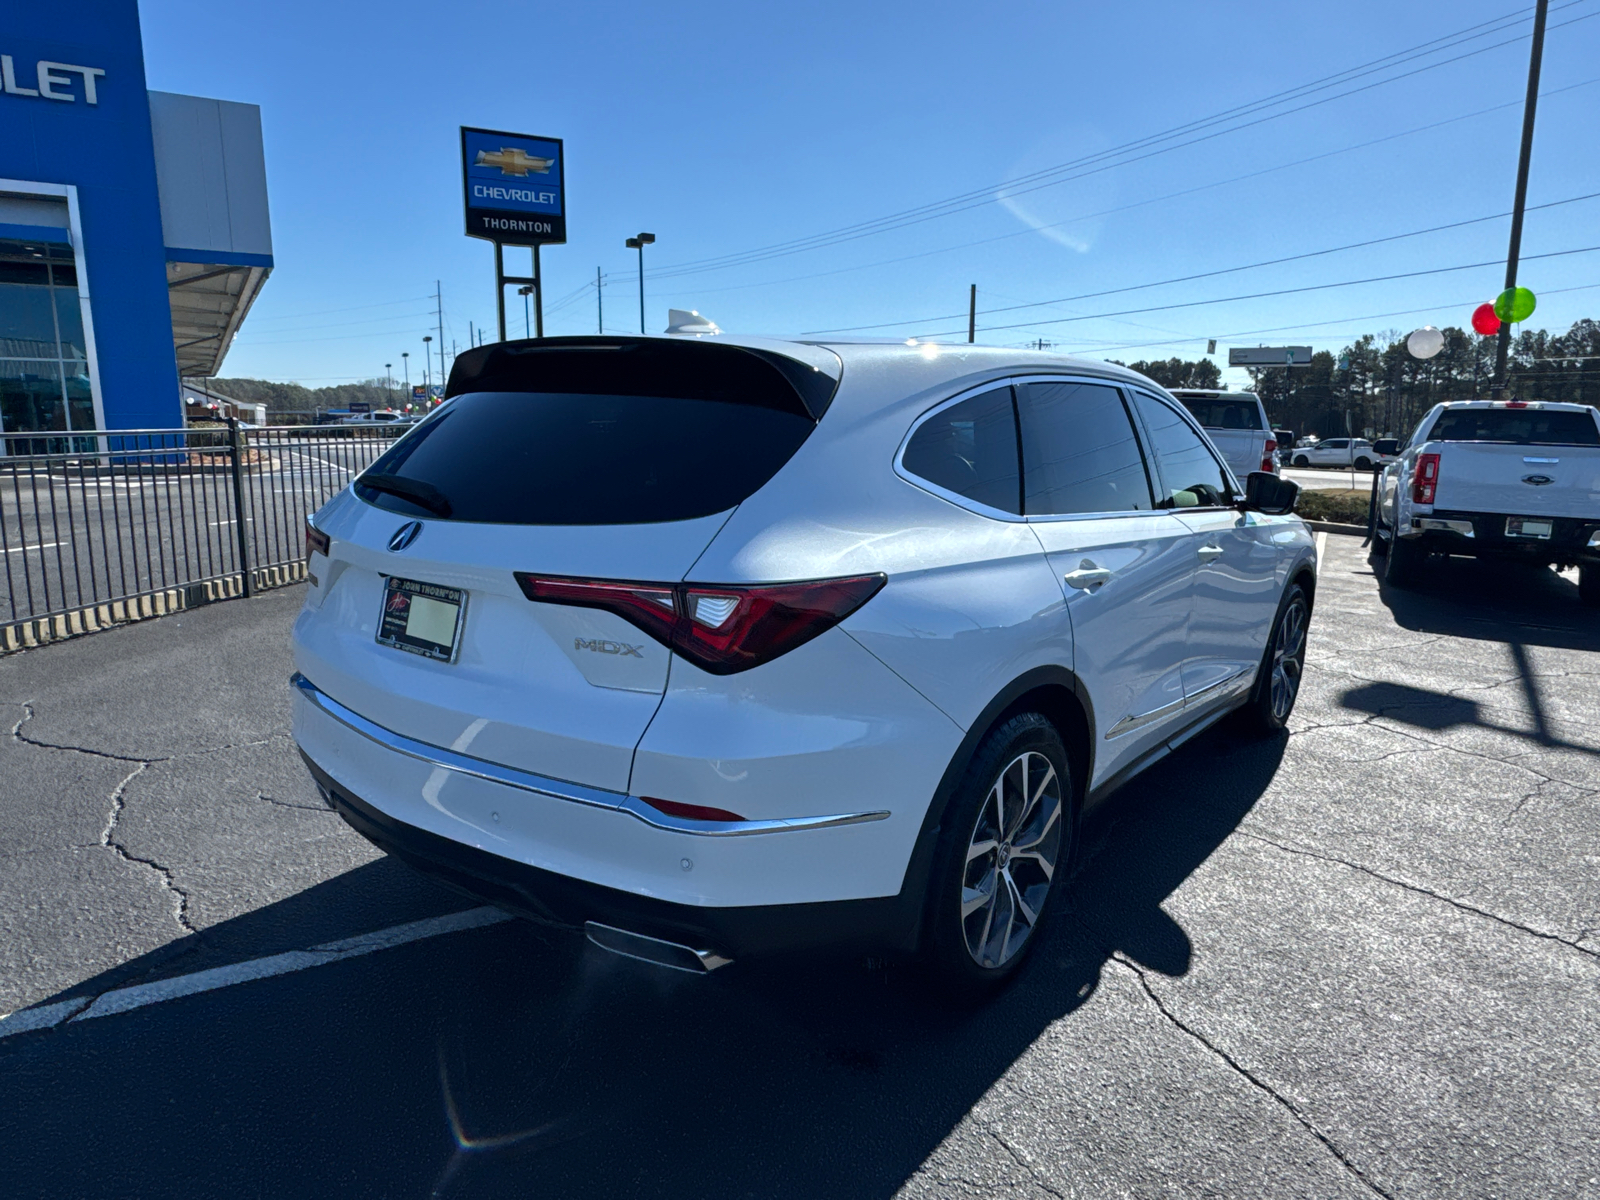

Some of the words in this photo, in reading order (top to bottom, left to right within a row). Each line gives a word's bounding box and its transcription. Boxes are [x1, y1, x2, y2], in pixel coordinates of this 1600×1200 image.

[0, 54, 106, 105] LET
[473, 184, 557, 205] CHEVROLET
[482, 216, 552, 234] THORNTON
[402, 581, 420, 592] JOHN
[421, 585, 459, 600] THORNTON
[574, 637, 645, 659] MDX
